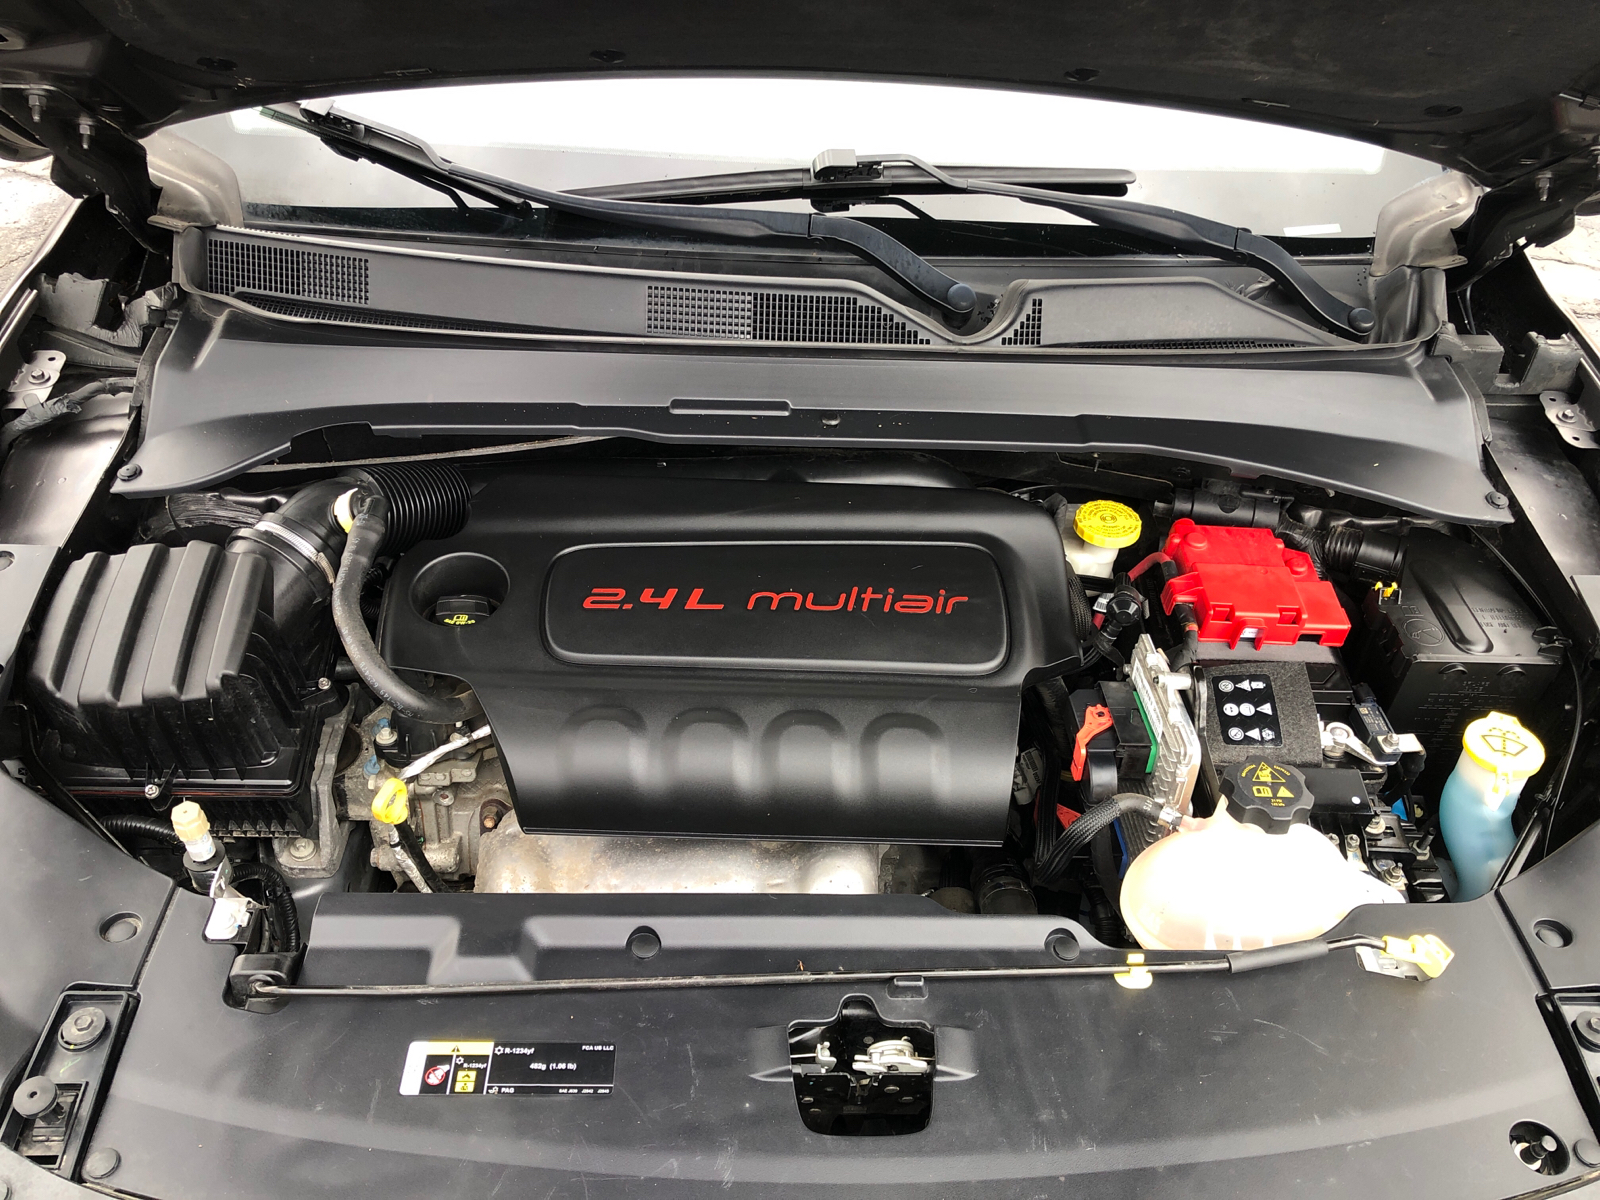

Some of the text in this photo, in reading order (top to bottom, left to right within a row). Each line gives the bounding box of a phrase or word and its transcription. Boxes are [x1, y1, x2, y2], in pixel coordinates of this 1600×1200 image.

[582, 586, 969, 614] 2.4L multiair
[504, 1047, 535, 1056] R-1234yf
